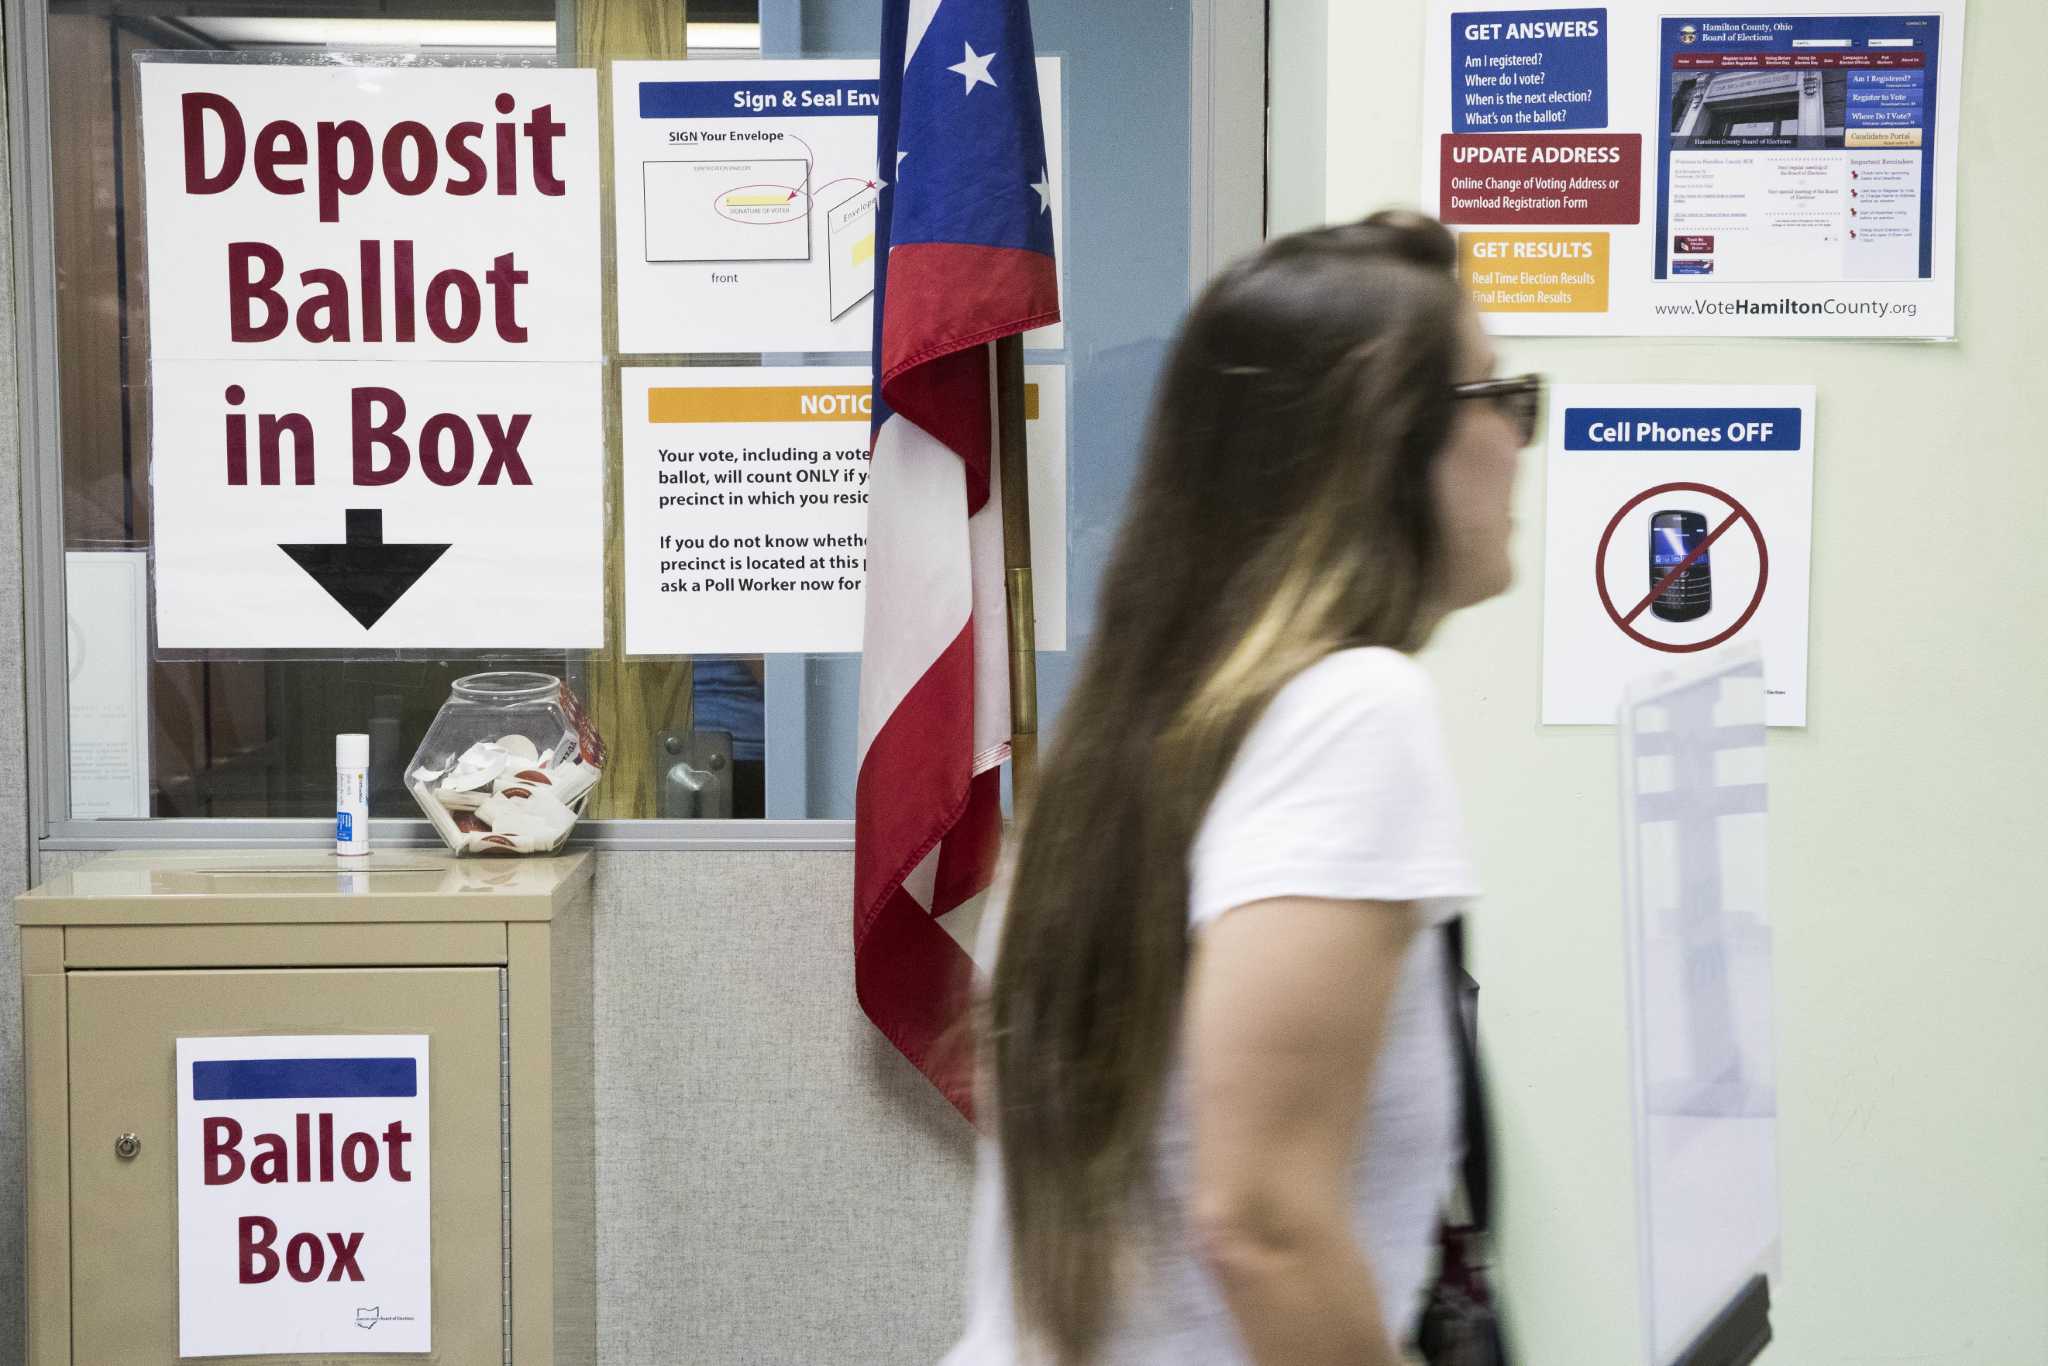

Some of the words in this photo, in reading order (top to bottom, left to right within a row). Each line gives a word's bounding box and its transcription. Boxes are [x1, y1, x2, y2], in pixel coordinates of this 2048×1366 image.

[1465, 23, 1502, 40] GET
[1506, 20, 1599, 40] ANSWERS
[1703, 23, 1739, 31] Hamilton
[1741, 23, 1772, 33] County,
[1773, 22, 1793, 31] Ohio
[1702, 33, 1726, 41] Board
[1728, 33, 1737, 41] of
[1737, 33, 1773, 41] Elections
[1465, 55, 1481, 68] Am
[1484, 55, 1487, 66] I
[1489, 53, 1543, 69] registered?
[1465, 74, 1496, 86] Where
[1499, 73, 1511, 85] do
[1514, 73, 1517, 85] I
[1519, 72, 1545, 84] vote?
[734, 91, 777, 112] Sign
[782, 90, 796, 107] &
[802, 89, 841, 107] Seal
[1465, 93, 1494, 105] When
[1496, 93, 1504, 105] is
[1506, 92, 1522, 104] the
[1525, 92, 1546, 104] next
[1549, 89, 1592, 103] election?
[1465, 112, 1498, 125] What's
[1501, 114, 1513, 124] on
[1515, 111, 1531, 123] the
[1534, 109, 1567, 122] ballot?
[669, 132, 698, 142] SIGN
[701, 131, 727, 142] Your
[730, 130, 784, 143] Envelope
[182, 92, 566, 223] Deposit
[1453, 147, 1527, 163] UPDATE
[1532, 146, 1620, 163] ADDRESS
[1452, 177, 1483, 189] Online
[1485, 177, 1521, 192] Change
[1523, 177, 1534, 189] of
[1534, 177, 1566, 192] Voting
[1569, 177, 1607, 189] Address
[1609, 179, 1620, 189] or
[1452, 196, 1500, 209] Download
[1503, 196, 1561, 211] Registration
[1564, 196, 1588, 208] Form
[1472, 242, 1508, 258] GET
[1514, 241, 1593, 258] RESULTS
[711, 272, 738, 283] front
[1472, 272, 1493, 285] Real
[1495, 272, 1518, 284] Time
[1520, 272, 1559, 284] Election
[1560, 272, 1595, 284] Results
[228, 240, 528, 344] Ballot
[1472, 291, 1495, 304] Final
[1497, 291, 1535, 304] Election
[1537, 291, 1572, 304] Results
[1655, 299, 1917, 318] www.VoteHamiltonCounty.org
[225, 385, 315, 486] in
[352, 387, 533, 487] Box
[1588, 421, 1630, 443] Cell
[1636, 421, 1721, 443] Phones
[1727, 422, 1774, 443] OFF
[659, 450, 694, 462] Your
[699, 450, 738, 464] vote,
[743, 448, 818, 465] including
[823, 451, 831, 461] a
[659, 470, 710, 485] ballot,
[714, 470, 743, 483] will
[747, 471, 792, 484] count
[796, 469, 839, 482] ONLY
[844, 469, 855, 482] if
[660, 492, 724, 509] precinct
[729, 492, 743, 505] in
[748, 491, 795, 505] which
[800, 494, 829, 508] you
[661, 536, 671, 549] If
[675, 539, 705, 553] you
[709, 535, 729, 548] do
[734, 536, 760, 548] not
[766, 534, 808, 548] know
[813, 533, 867, 547] wheth
[661, 557, 725, 574] precinct
[731, 557, 742, 569] is
[747, 556, 805, 569] located
[810, 557, 825, 569] at
[829, 555, 859, 569] this
[661, 579, 687, 592] ask
[692, 583, 700, 592] a
[706, 578, 734, 591] Poll
[739, 578, 796, 592] Worker
[801, 580, 834, 591] now
[838, 577, 861, 590] for
[203, 1113, 412, 1186] Ballot
[238, 1215, 366, 1285] Box
